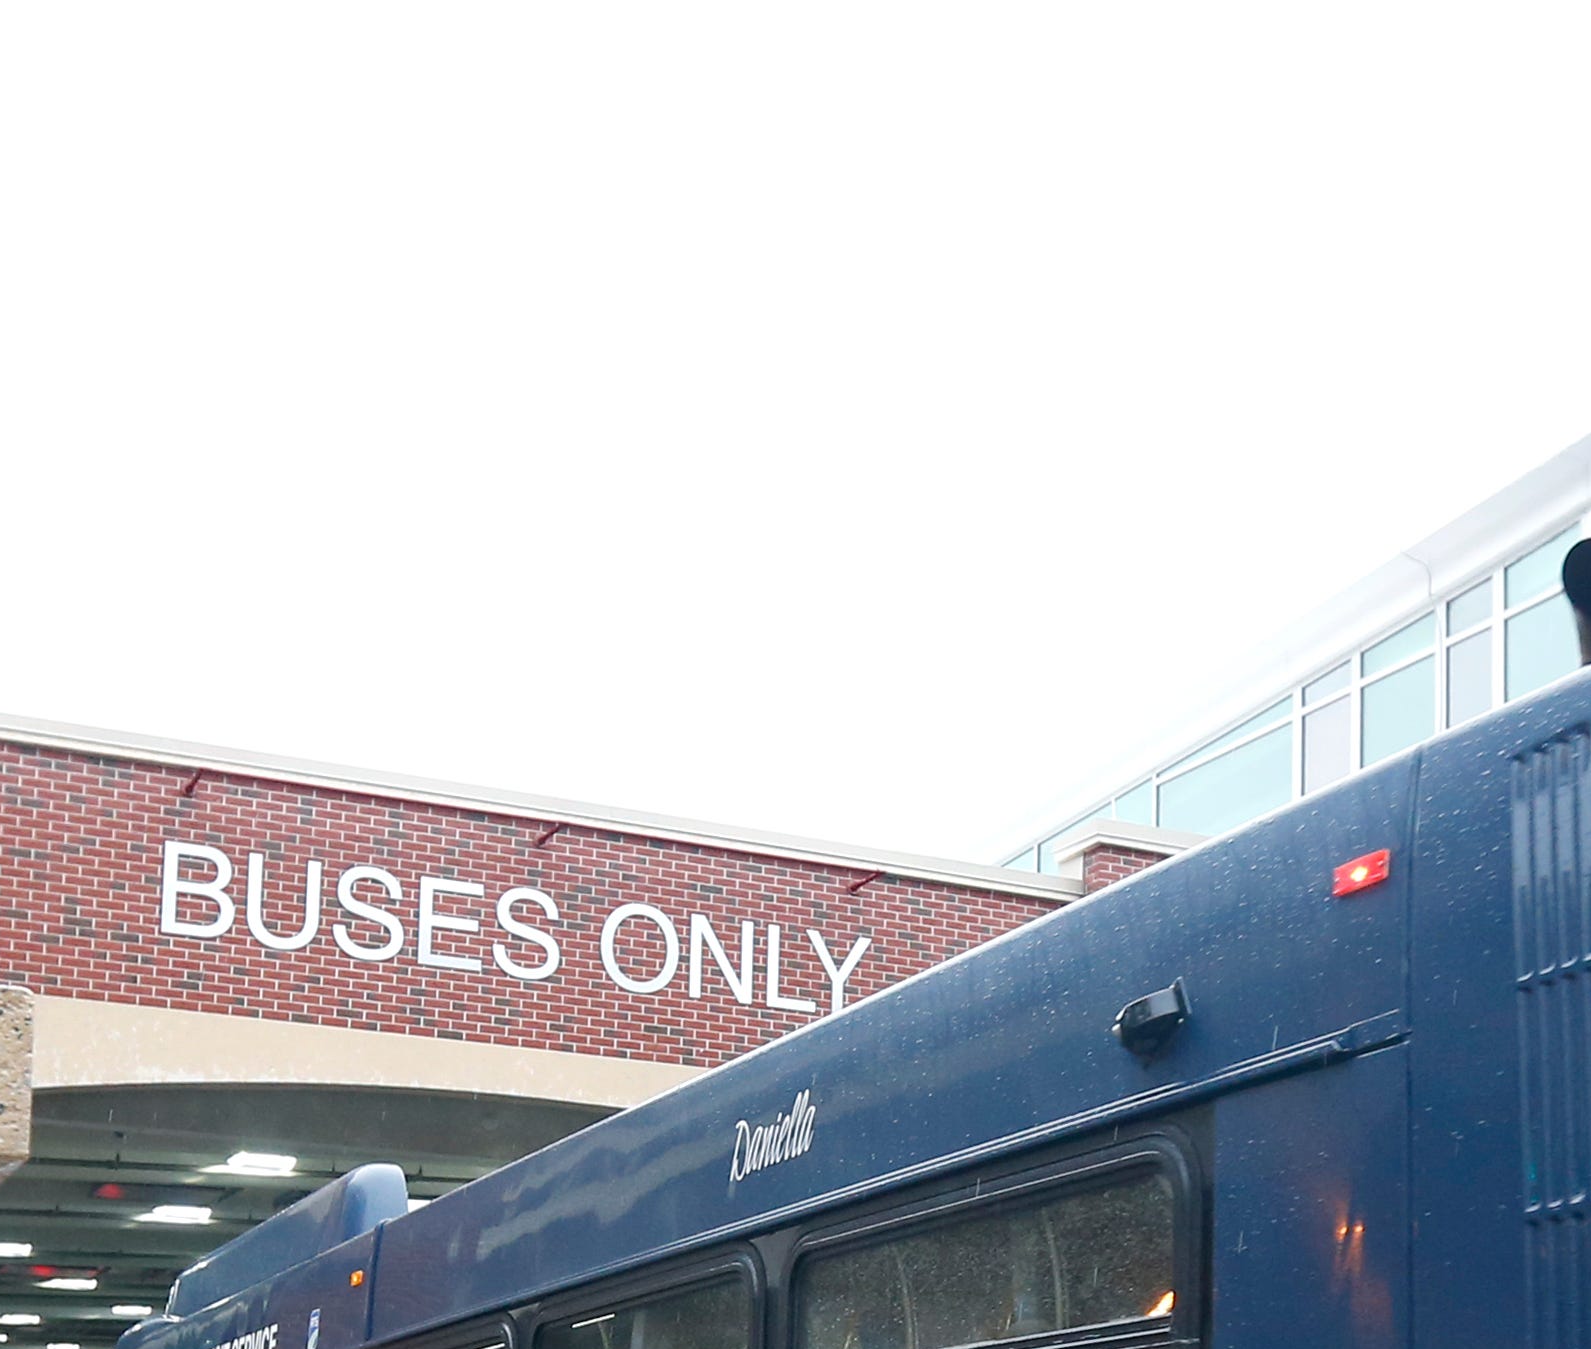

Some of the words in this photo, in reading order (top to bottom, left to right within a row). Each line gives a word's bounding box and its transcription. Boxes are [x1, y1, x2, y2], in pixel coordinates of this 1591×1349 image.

[159, 839, 562, 981] BUSES
[602, 903, 872, 1012] ONLY
[729, 1088, 816, 1182] Daniella
